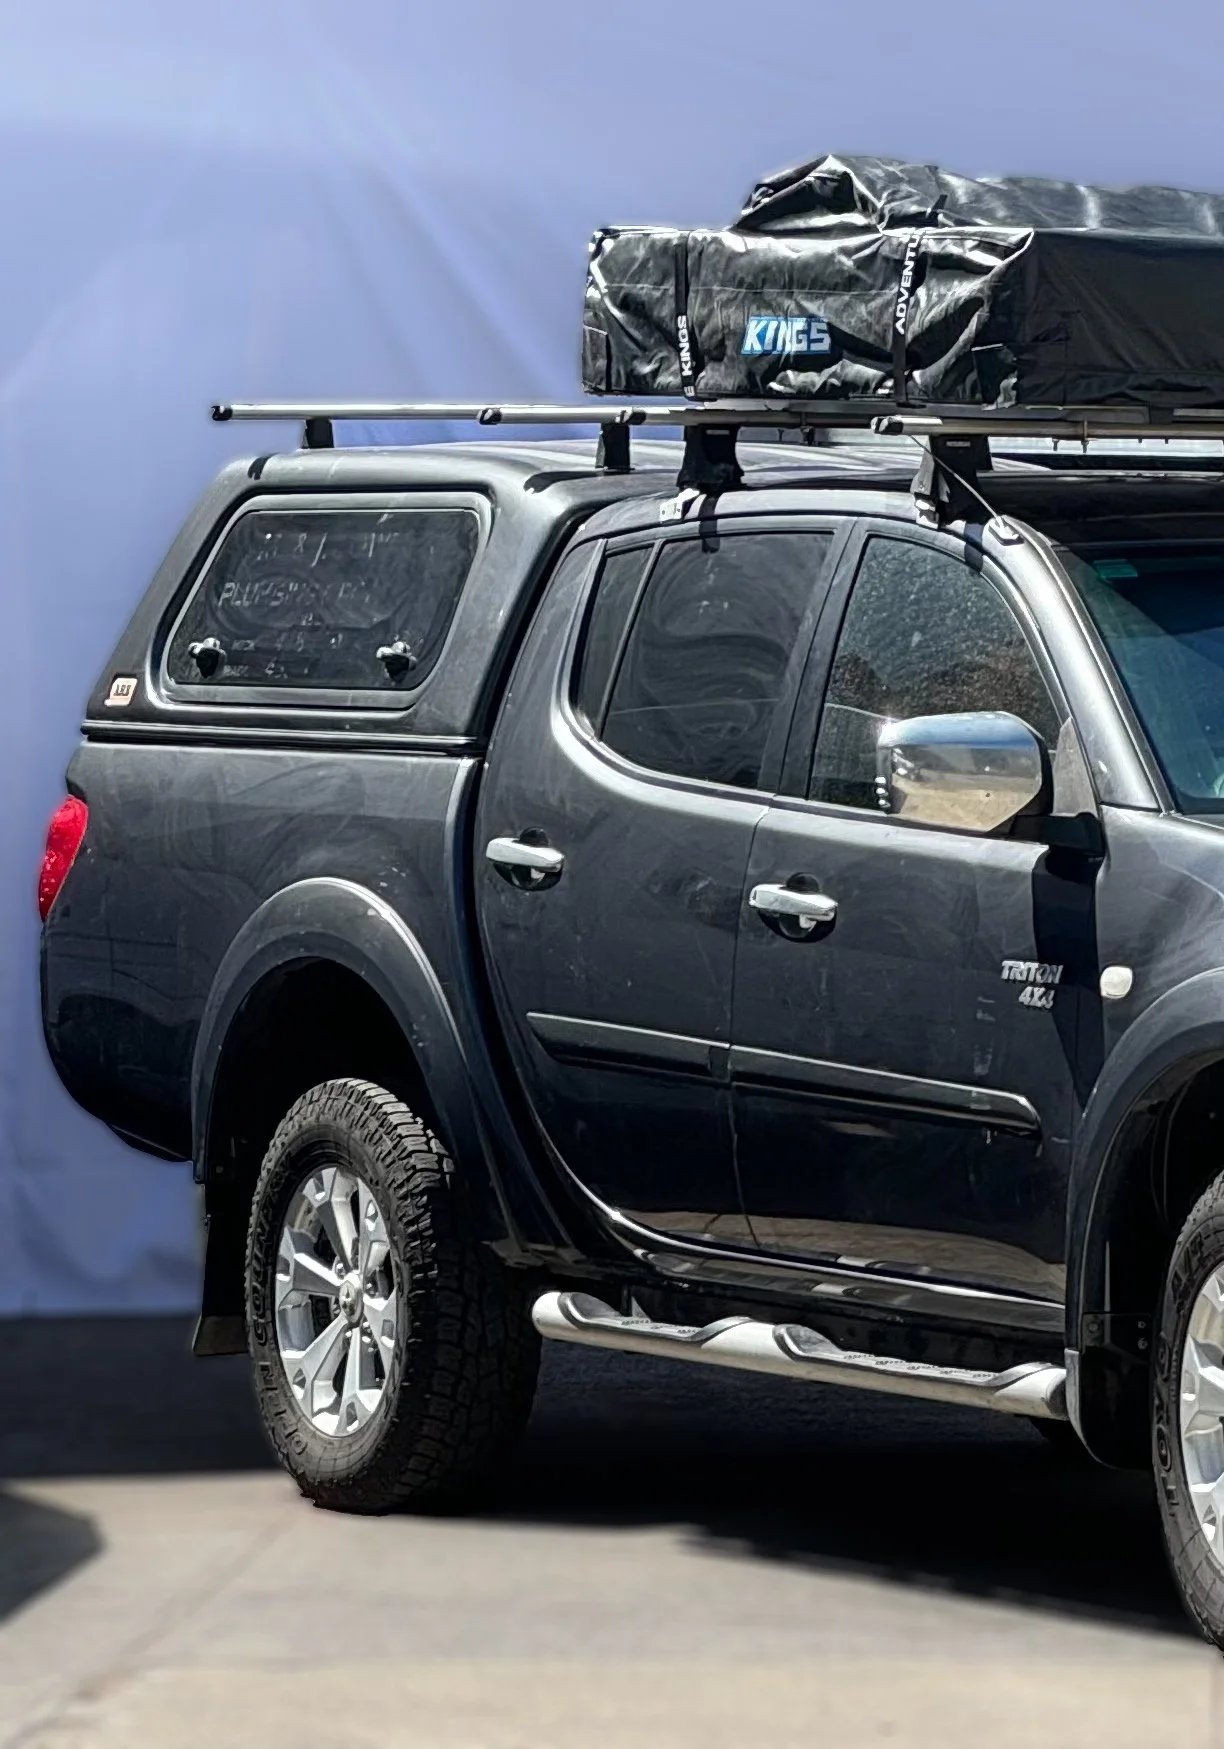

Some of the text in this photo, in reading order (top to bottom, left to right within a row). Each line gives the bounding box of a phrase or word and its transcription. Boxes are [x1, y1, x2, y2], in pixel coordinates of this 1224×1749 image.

[677, 315, 693, 377] KINGS
[741, 318, 832, 353] KINGS
[1000, 960, 1064, 984] TRITON
